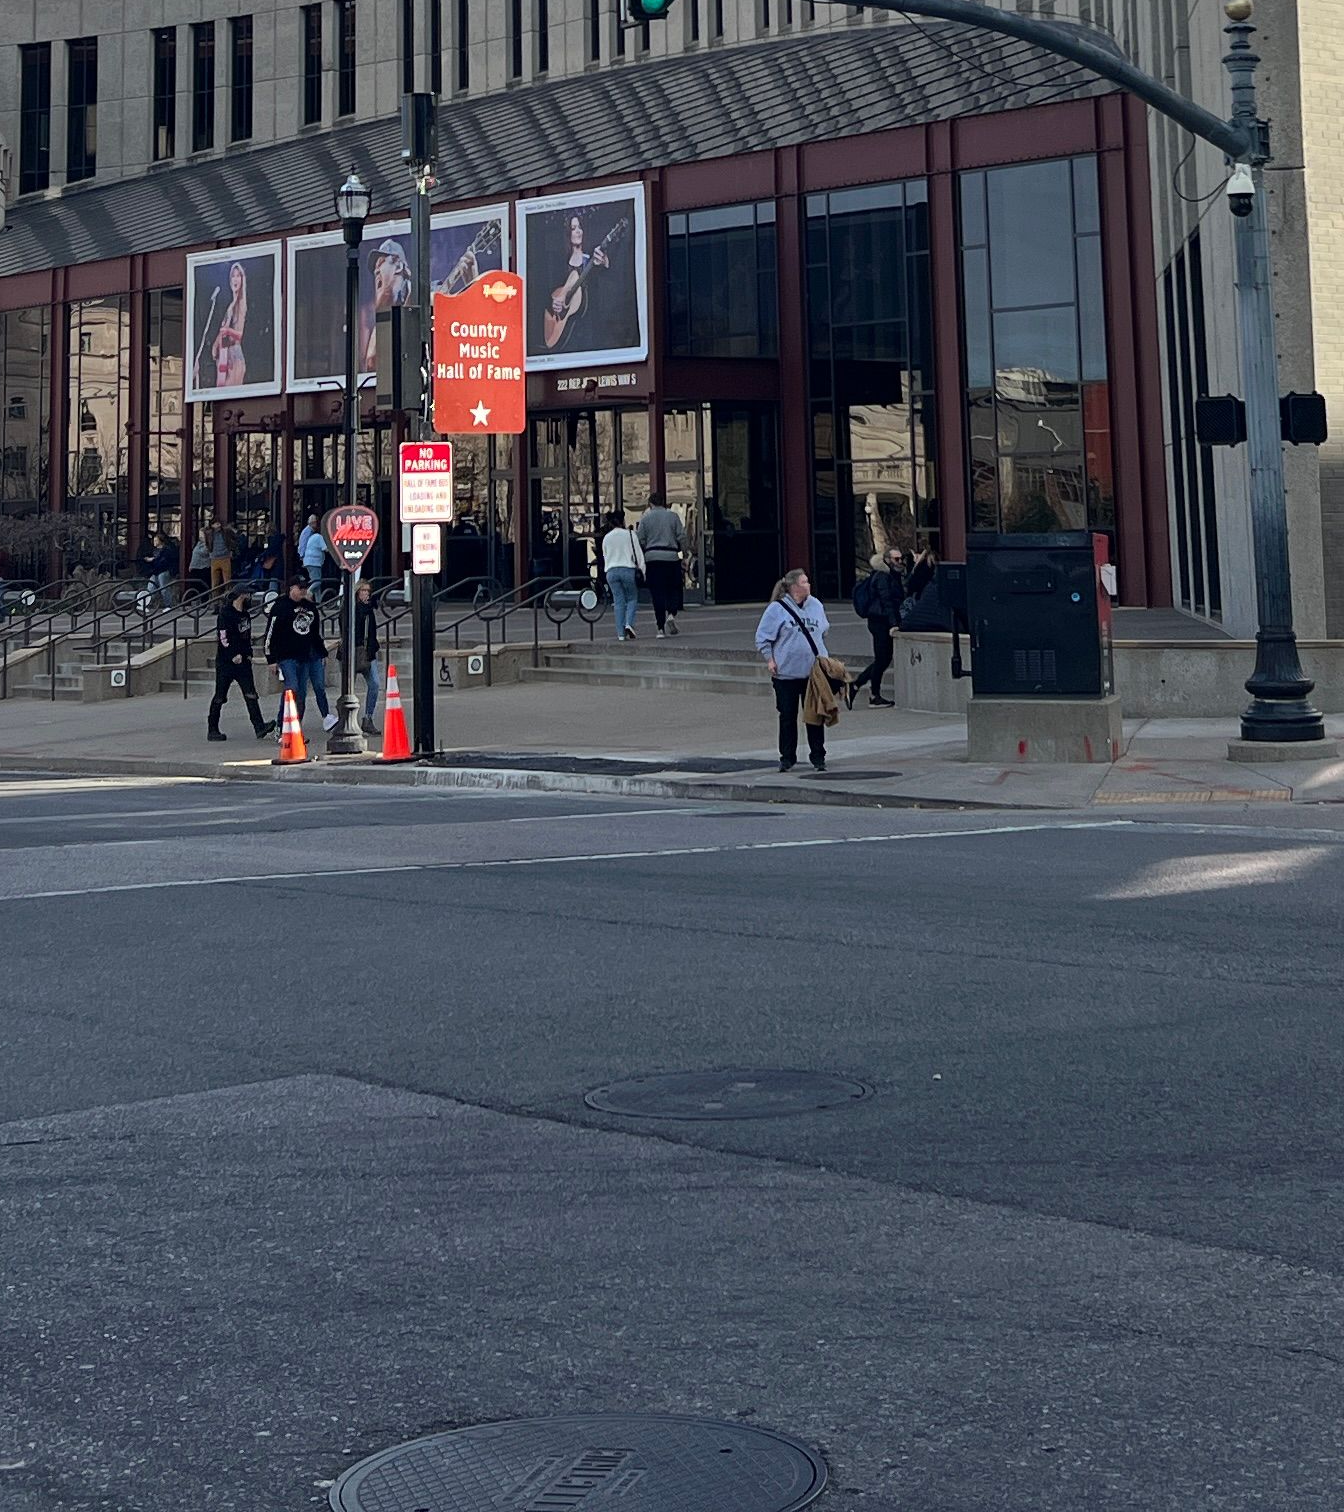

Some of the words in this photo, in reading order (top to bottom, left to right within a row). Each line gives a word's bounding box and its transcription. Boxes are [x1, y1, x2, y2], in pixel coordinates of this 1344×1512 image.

[450, 321, 508, 343] Country
[459, 342, 500, 359] Music
[437, 362, 464, 379] Hall
[469, 363, 483, 379] of
[487, 364, 521, 380] Fame
[631, 373, 636, 385] S
[419, 447, 433, 459] NO
[404, 459, 448, 471] PARKING
[336, 515, 372, 530] LIVE
